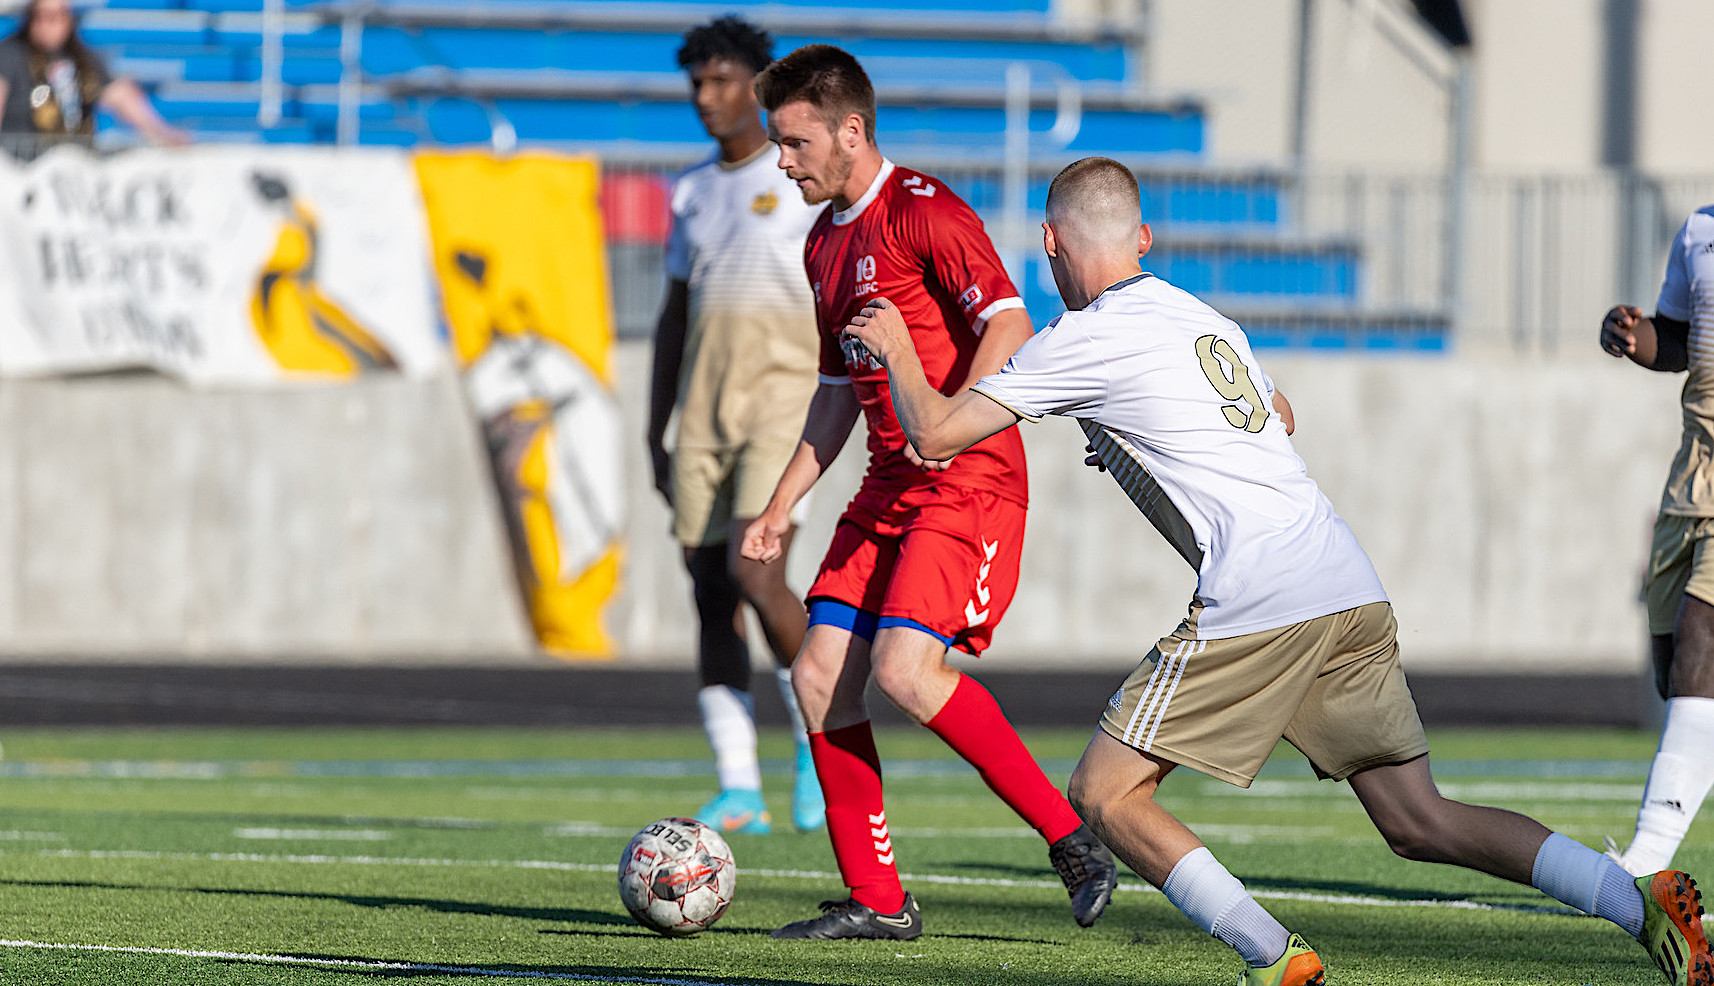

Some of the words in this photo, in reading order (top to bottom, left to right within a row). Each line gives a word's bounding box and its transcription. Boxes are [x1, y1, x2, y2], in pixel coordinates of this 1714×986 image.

[856, 255, 876, 282] 10
[855, 281, 879, 297] LUFC
[1195, 334, 1270, 433] 9
[640, 824, 692, 852] SELEC
